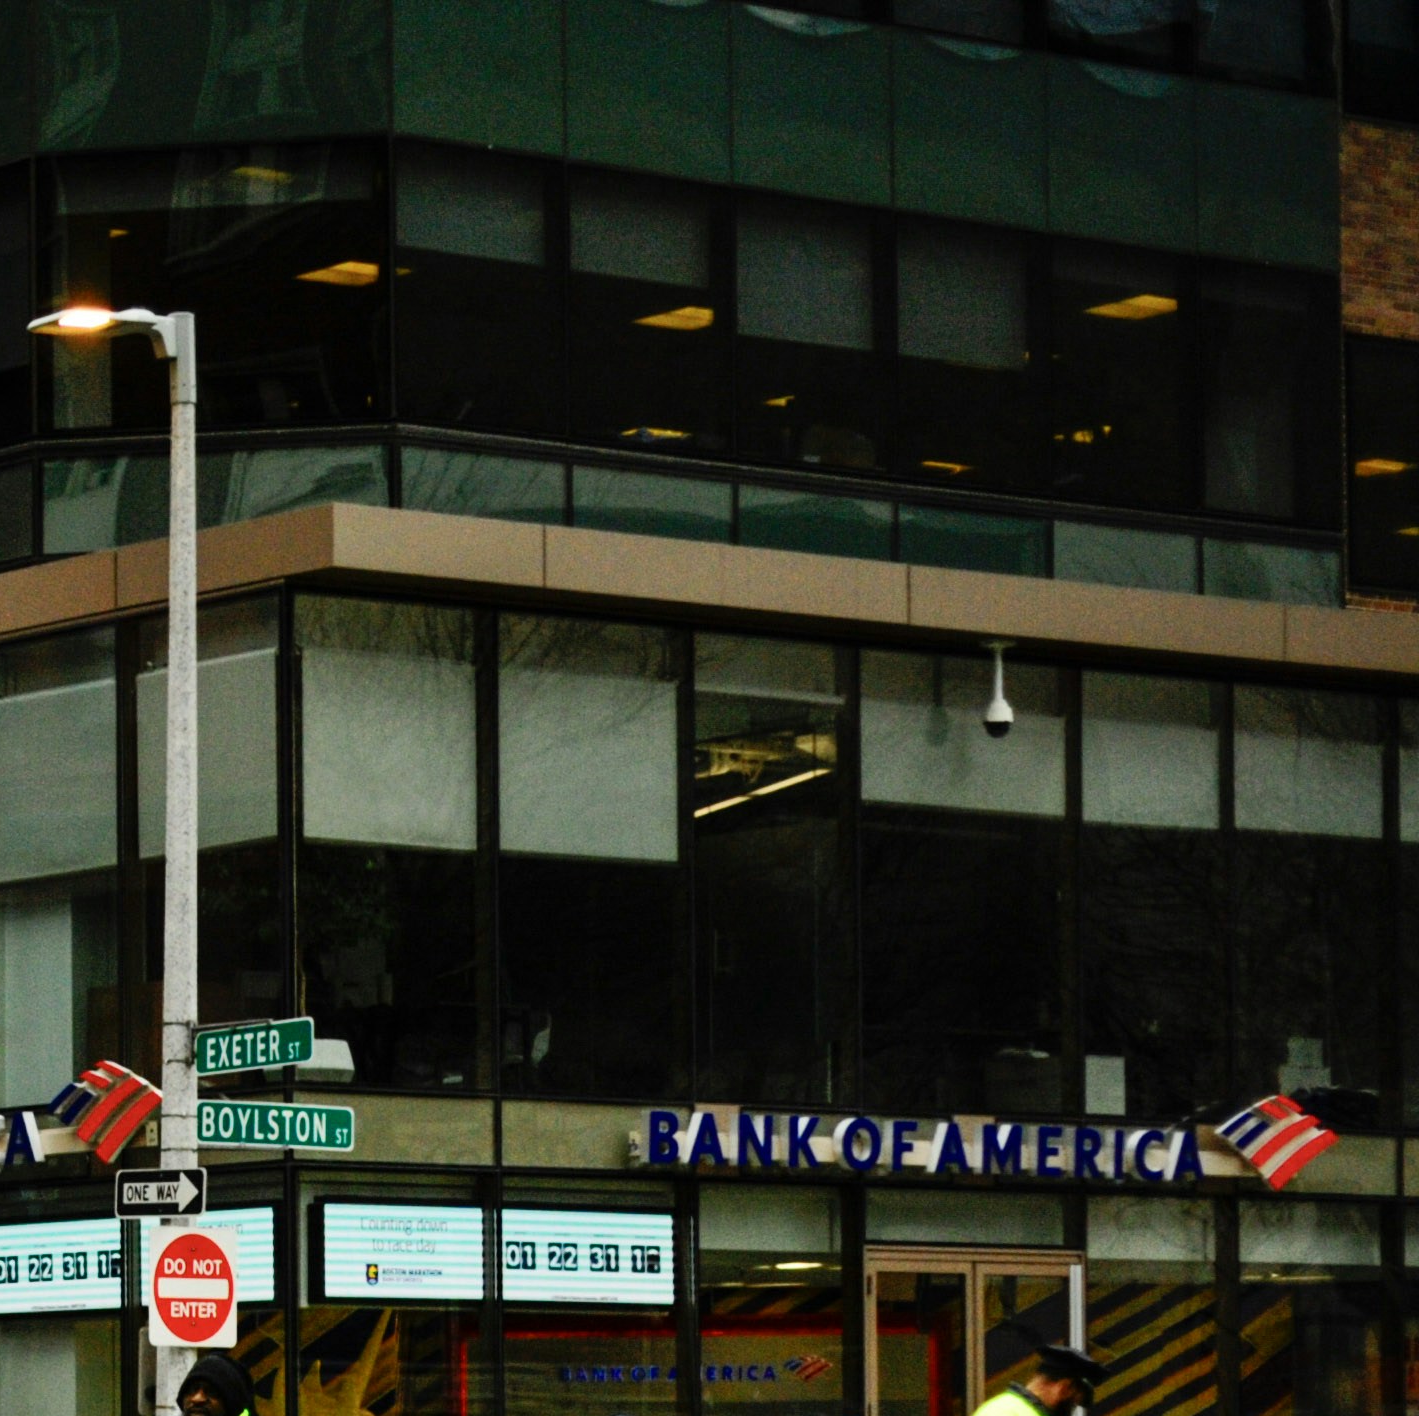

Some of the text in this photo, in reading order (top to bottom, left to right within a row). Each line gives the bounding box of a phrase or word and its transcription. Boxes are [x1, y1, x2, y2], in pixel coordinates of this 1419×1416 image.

[206, 1030, 300, 1069] EXETER ST
[201, 1106, 349, 1144] BOYLSTON ST
[647, 1110, 1205, 1181] BANK OF AMERICA
[126, 1184, 179, 1201] ONE WAY
[360, 1217, 448, 1236] Counting down
[29, 1256, 52, 1280] 22
[63, 1254, 87, 1278] 31
[164, 1258, 223, 1276] DO NOT
[506, 1244, 534, 1268] 01
[548, 1245, 577, 1269] 22
[590, 1246, 618, 1270] 31
[170, 1302, 217, 1319] ENTER
[667, 1366, 777, 1383] AERICA
